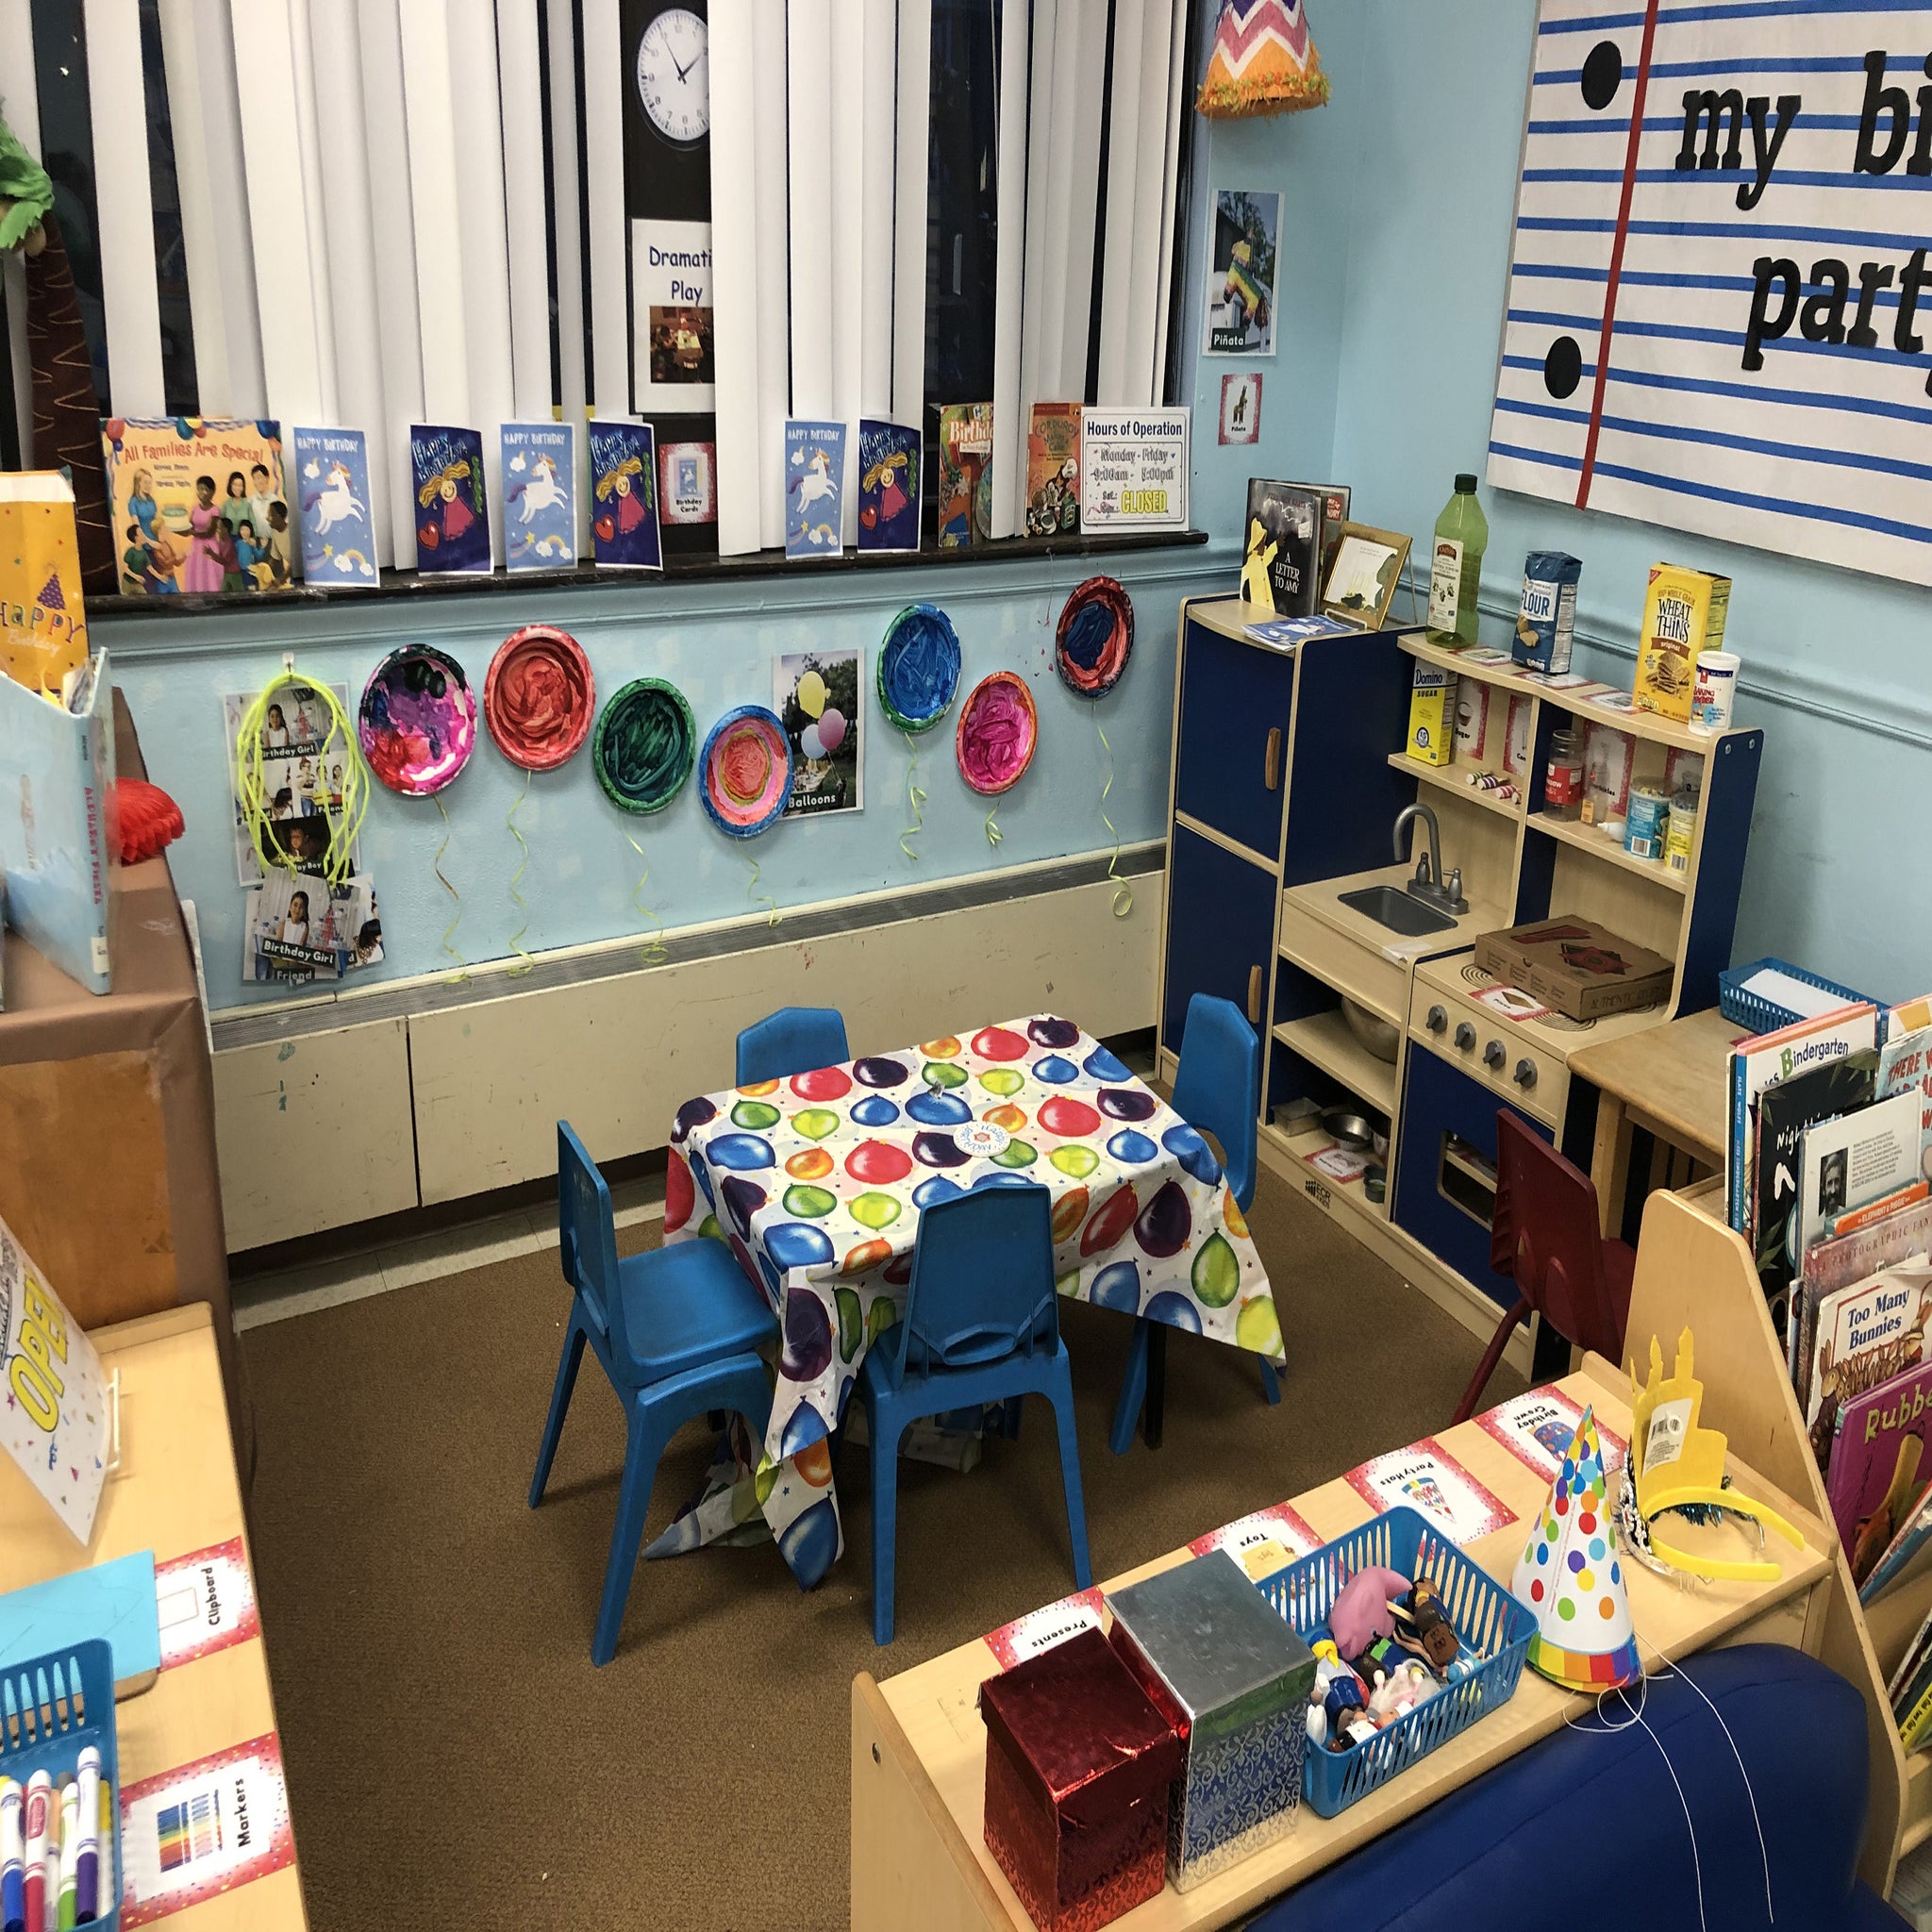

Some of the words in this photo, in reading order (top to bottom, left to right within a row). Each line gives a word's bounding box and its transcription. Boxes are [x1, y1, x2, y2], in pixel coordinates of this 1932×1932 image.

[1675, 89, 1801, 211] my
[649, 245, 712, 268] Dramati
[671, 280, 703, 307] Play
[1741, 248, 1932, 398] part
[1213, 335, 1244, 346] Piñata
[504, 433, 528, 445] HAPPY
[531, 433, 565, 445] BIRTHDAY
[788, 430, 809, 441] HAPPY
[810, 430, 840, 441] BIRTHDAY
[1088, 422, 1118, 436] Hours
[1120, 421, 1131, 436] of
[1133, 421, 1182, 439] Operation
[125, 445, 140, 464] All
[142, 441, 192, 459] Families
[194, 441, 218, 457] Are
[222, 443, 264, 463] Special
[297, 437, 322, 451] HAPPY
[324, 439, 358, 453] BIRTHDAY
[1101, 449, 1136, 464] Monday
[1142, 448, 1168, 463] Friday
[1121, 490, 1167, 514] CLOSED
[1284, 552, 1291, 563] A
[1275, 561, 1300, 581] LETTER
[1274, 575, 1284, 591] TO
[1285, 579, 1300, 594] AMY
[1657, 598, 1693, 621] WHEAT
[1415, 669, 1443, 686] Domino
[1417, 690, 1438, 698] SUGAR
[262, 747, 296, 758] irthday
[297, 744, 314, 754] Girl
[789, 793, 836, 808] Balloons
[264, 941, 311, 961] Birthday
[312, 951, 334, 964] Girl
[276, 971, 312, 980] Friend
[1779, 1038, 1849, 1079] Bindergarten
[1888, 1051, 1922, 1087] THERE
[1847, 1306, 1871, 1328] Too
[1874, 1290, 1910, 1317] Many
[1849, 1315, 1902, 1351] Bunnies
[1513, 1406, 1546, 1421] Crown
[1517, 1408, 1559, 1430] Birthday
[1380, 1472, 1404, 1487] Hats
[1404, 1461, 1435, 1480] Party
[1239, 1534, 1268, 1547] Toys
[201, 1567, 220, 1626] Clipboard
[1031, 1619, 1088, 1648] Presents
[234, 1778, 252, 1847] Markers
